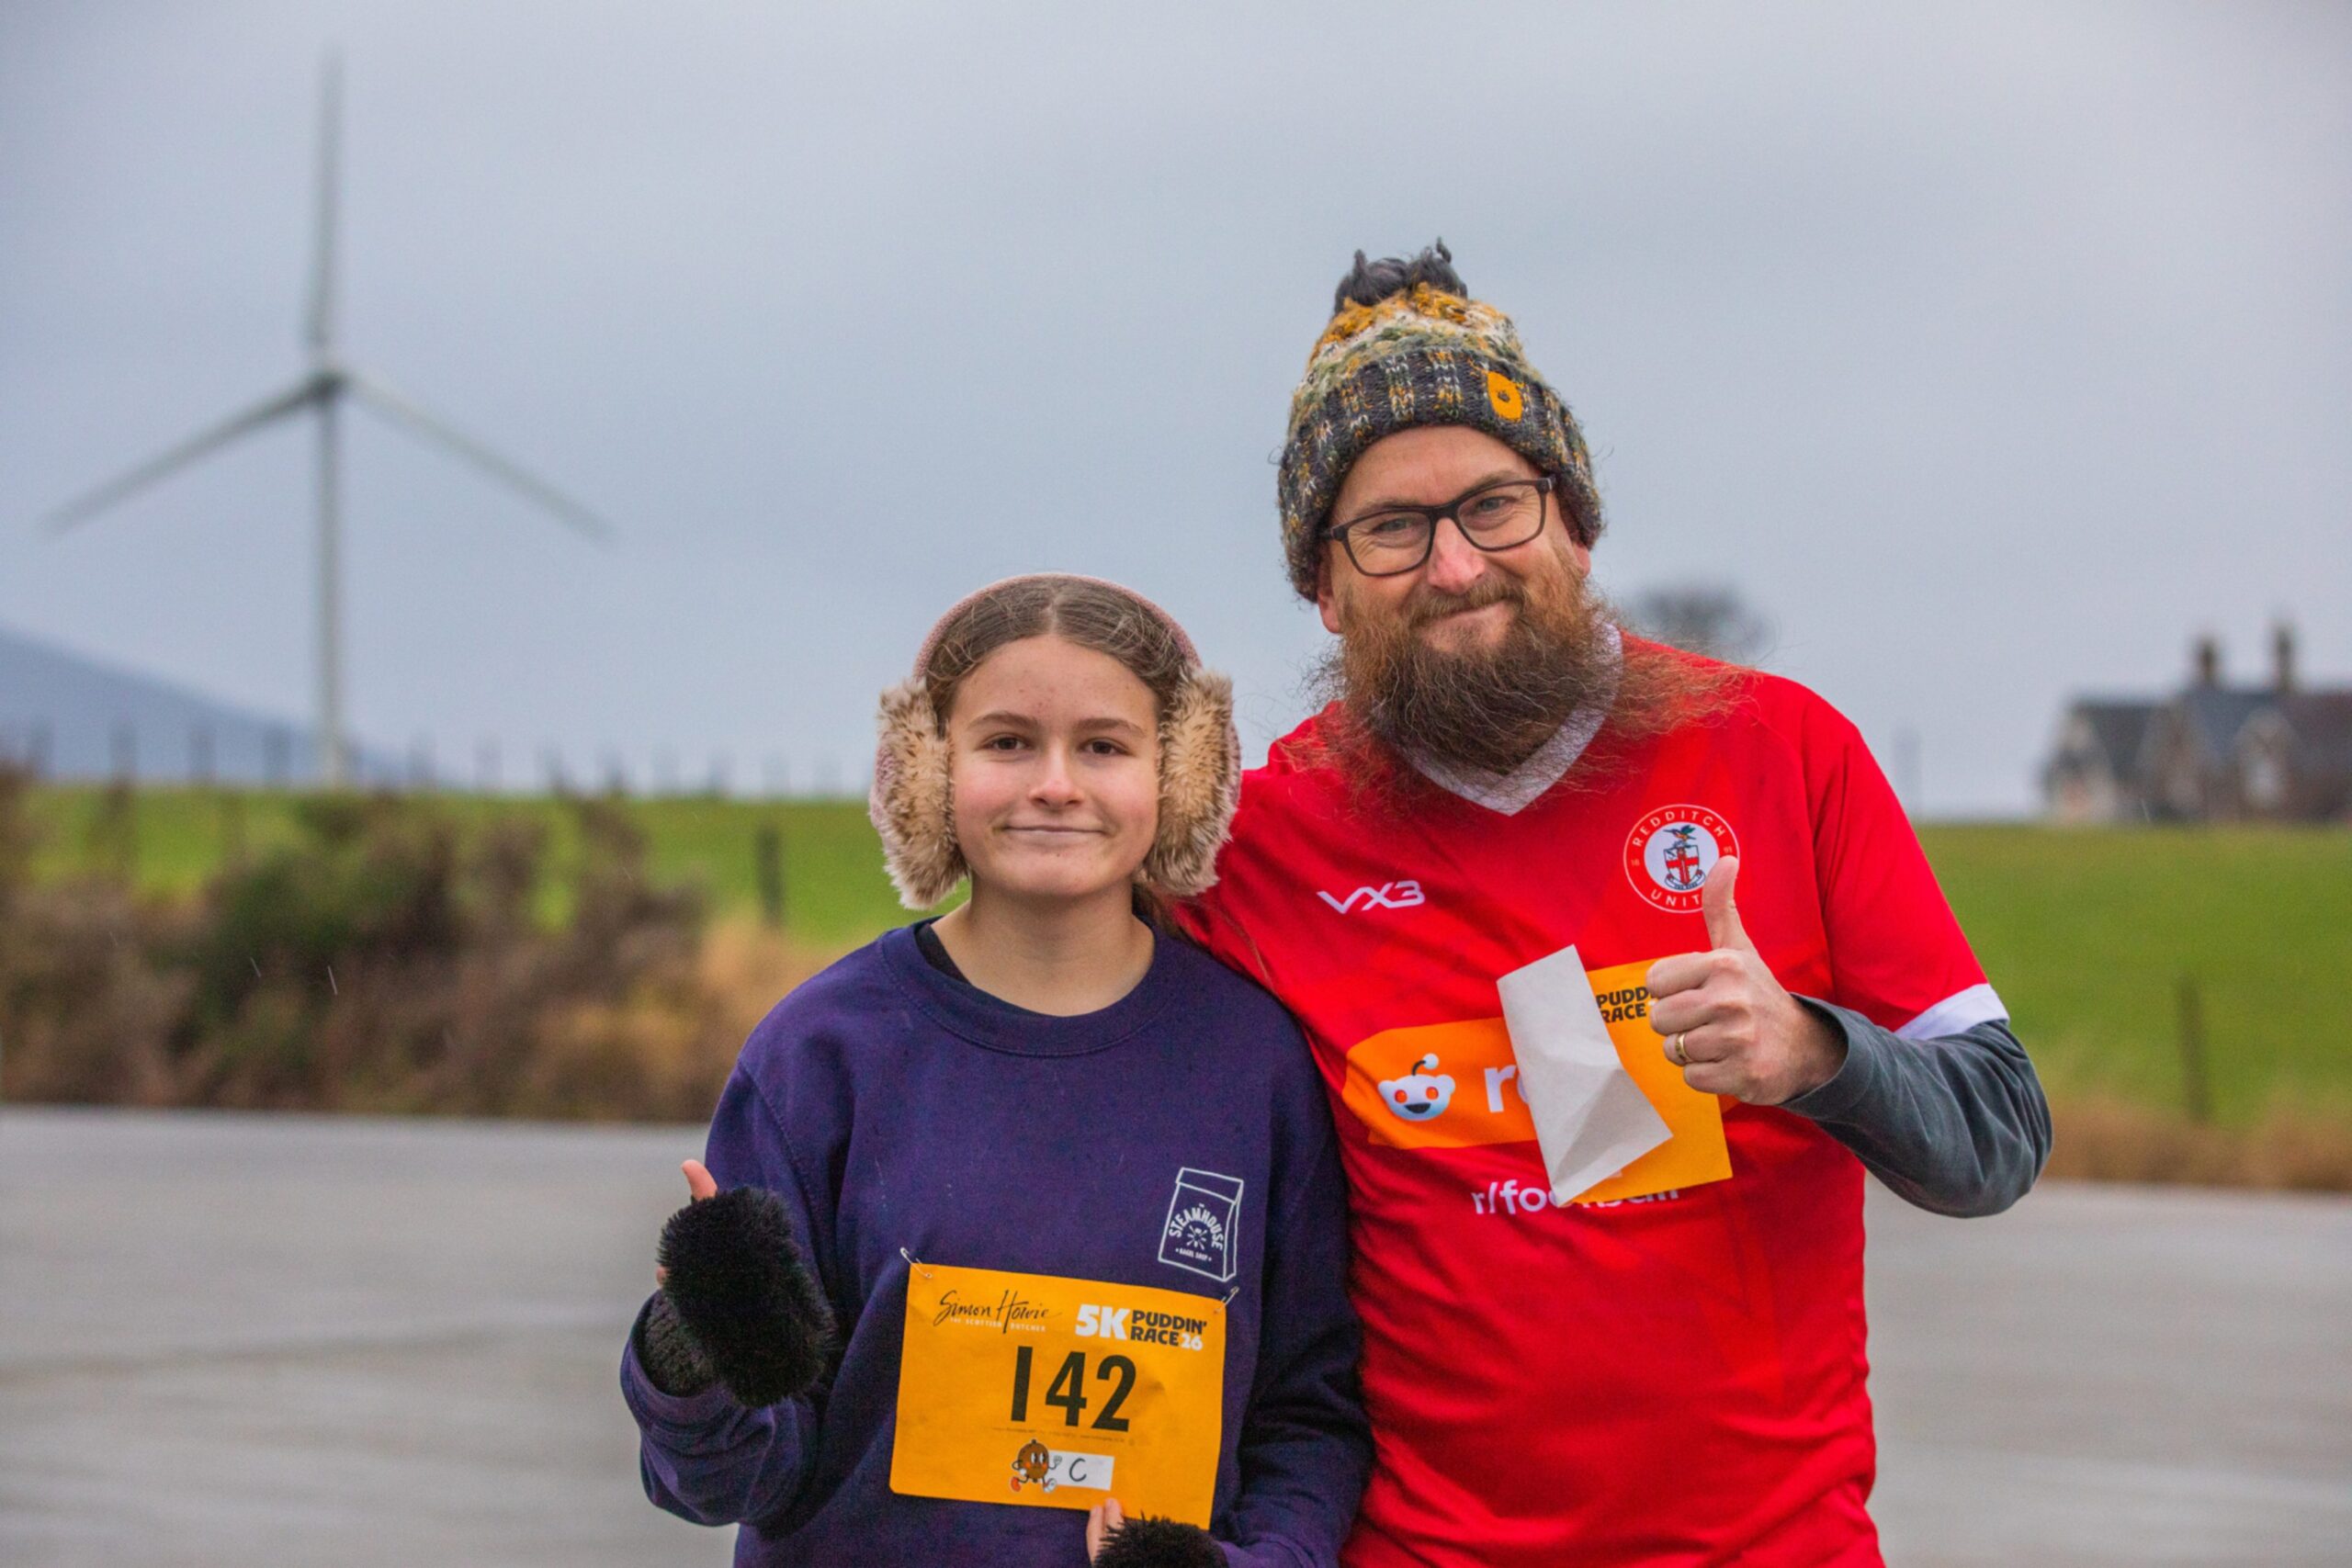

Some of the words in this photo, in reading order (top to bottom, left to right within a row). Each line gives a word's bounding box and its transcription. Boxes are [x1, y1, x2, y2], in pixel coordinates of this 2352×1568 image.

[1633, 810, 1725, 847] REDDITCH
[1316, 880, 1426, 914] VX3
[1651, 888, 1701, 908] UNIT
[1596, 987, 1653, 1009] PUDD
[1600, 1003, 1647, 1023] RACE
[1169, 1207, 1224, 1250] STEAMHOUSE
[933, 1290, 992, 1326] Simon
[997, 1289, 1062, 1334] Howie
[1075, 1303, 1131, 1340] 5K
[1131, 1310, 1207, 1335] PUDDIN'
[1130, 1325, 1180, 1347] RACE
[1180, 1332, 1204, 1351] 26
[1010, 1345, 1136, 1433] 142
